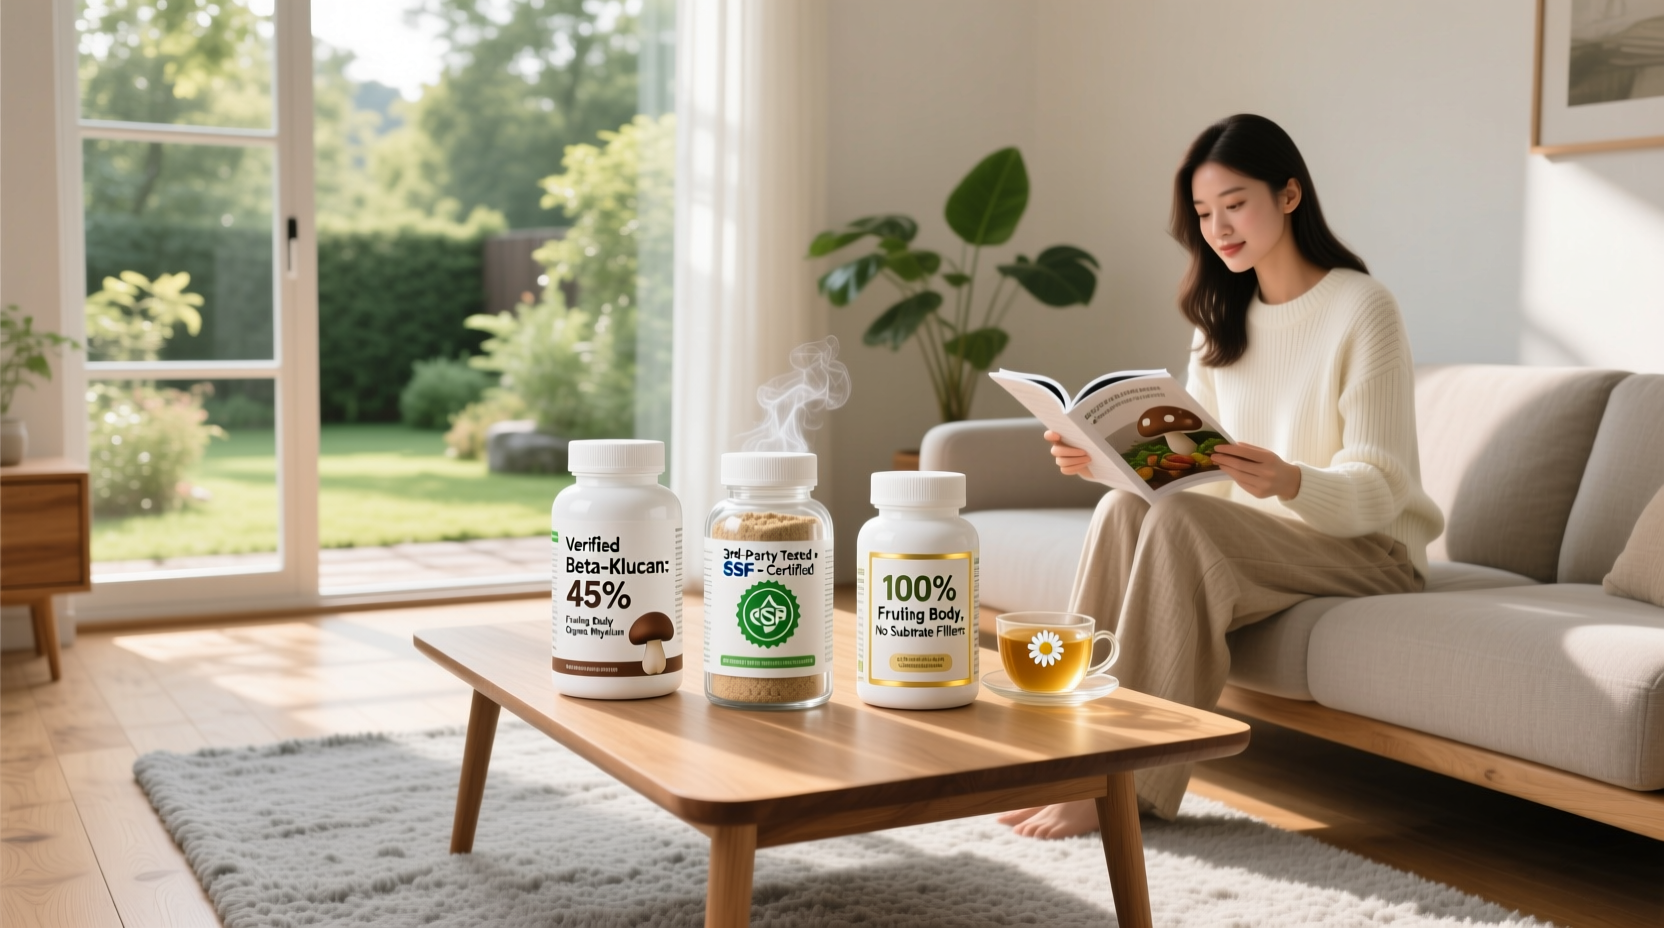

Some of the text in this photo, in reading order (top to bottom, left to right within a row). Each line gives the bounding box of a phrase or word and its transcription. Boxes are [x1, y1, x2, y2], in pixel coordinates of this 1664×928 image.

[566, 536, 620, 553] Verified
[723, 560, 754, 577] SSF
[567, 580, 631, 609] 45%
[883, 575, 957, 602] 100%
[929, 606, 964, 624] Body,
[875, 625, 888, 636] No
